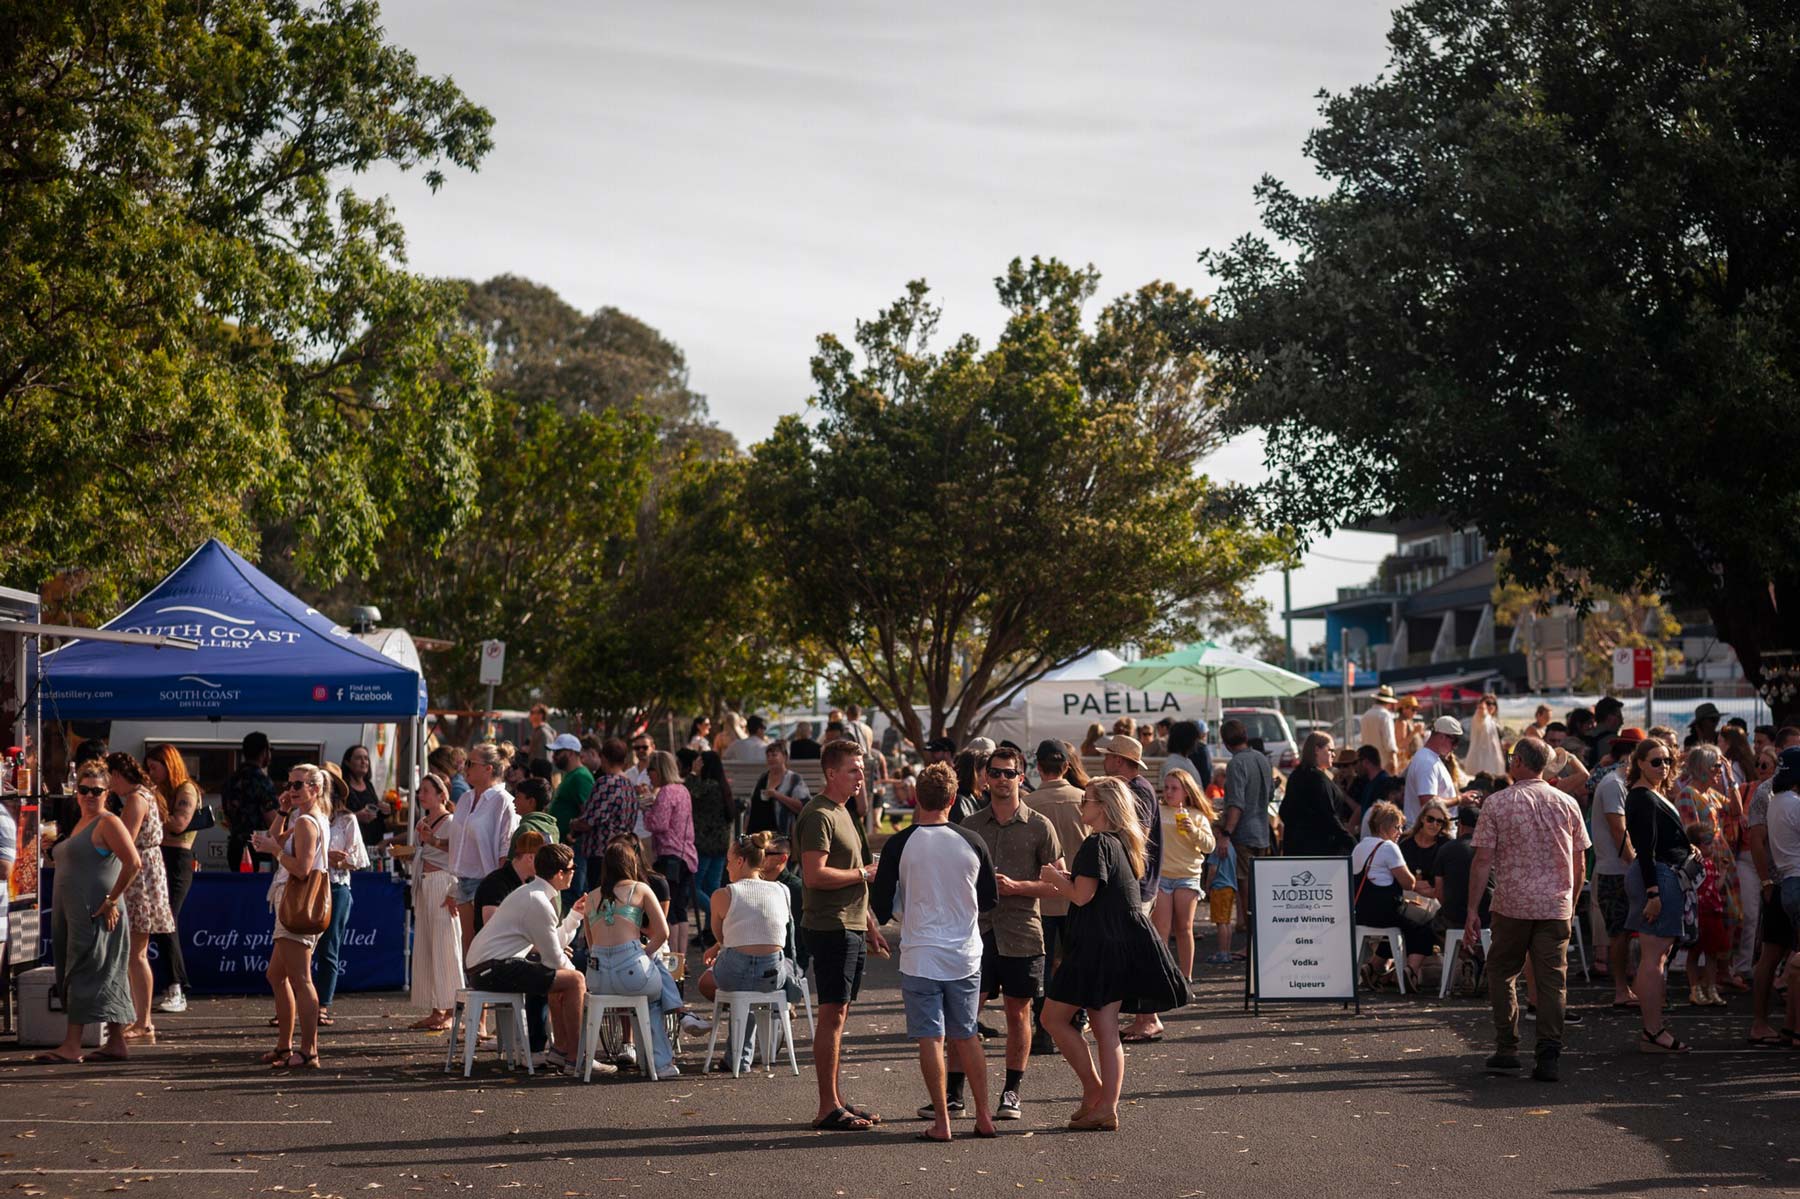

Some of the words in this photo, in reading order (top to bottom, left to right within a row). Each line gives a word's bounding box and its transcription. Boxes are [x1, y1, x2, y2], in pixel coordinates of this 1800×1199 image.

[117, 624, 203, 637] OUTH
[210, 625, 301, 643] COAST
[159, 690, 199, 700] SOUTH
[202, 690, 241, 700] COAST
[349, 691, 393, 701] Facebook
[1063, 692, 1181, 715] PAELLA
[1272, 889, 1333, 901] MOBIUS
[1300, 916, 1336, 924] Winning
[192, 929, 239, 950] Craft
[1295, 937, 1314, 945] Gins
[219, 955, 236, 973] in
[1291, 959, 1319, 967] Vodka
[1289, 981, 1326, 989] Liqueurs
